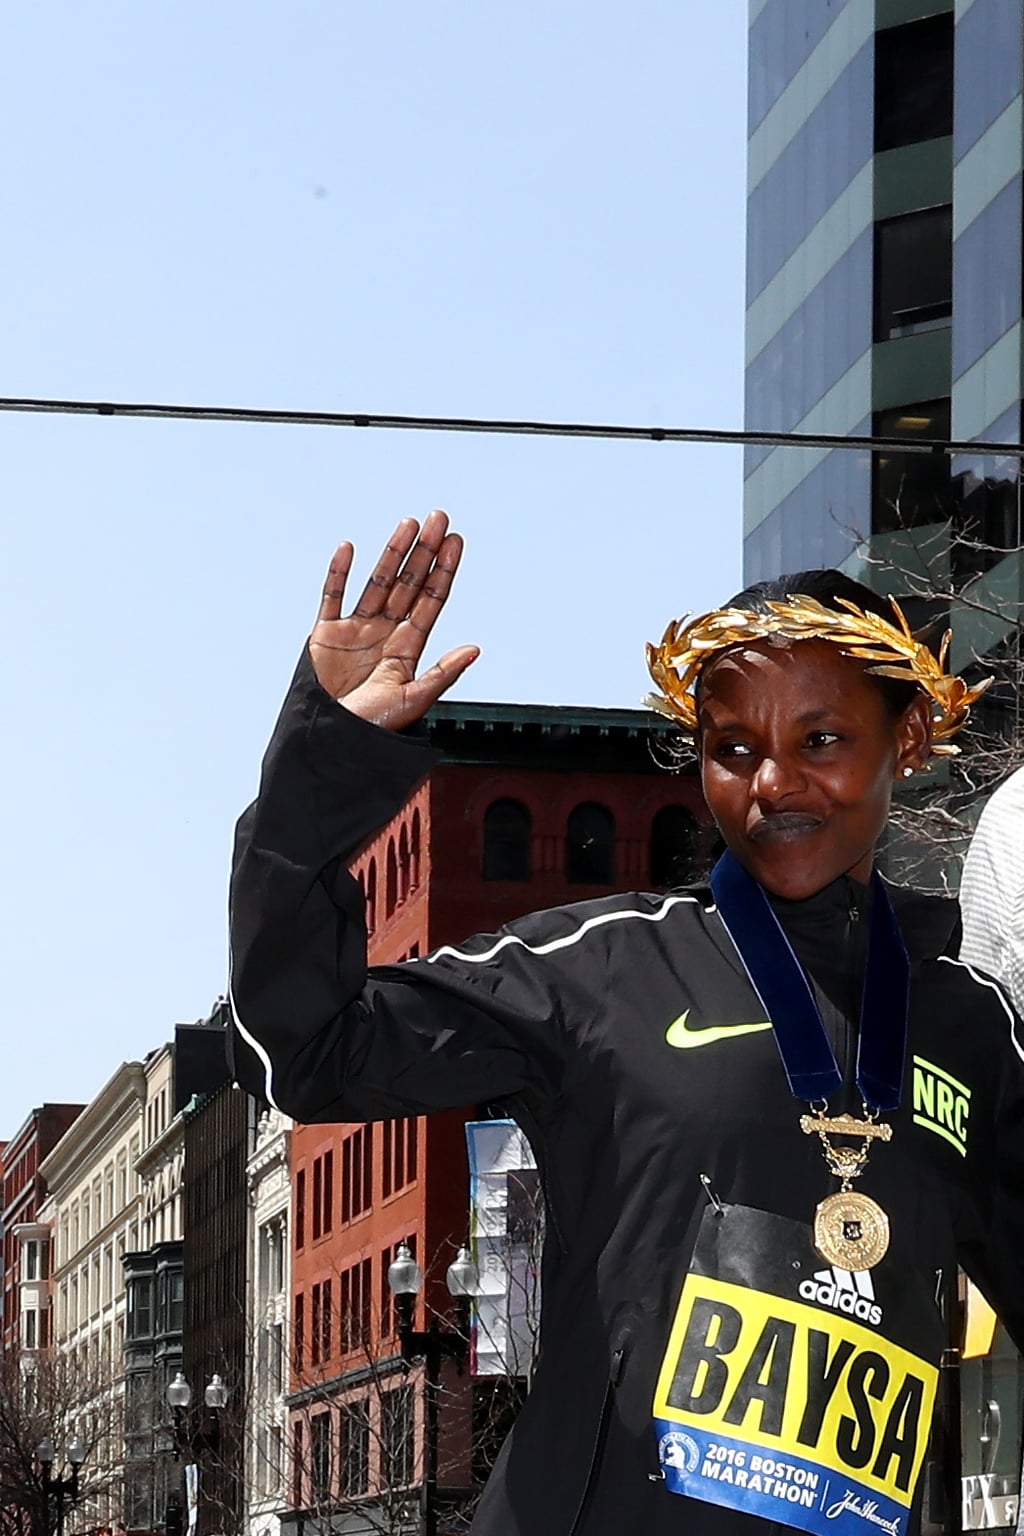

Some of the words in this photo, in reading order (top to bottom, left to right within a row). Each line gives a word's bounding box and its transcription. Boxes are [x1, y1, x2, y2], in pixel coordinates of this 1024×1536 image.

[912, 1068, 970, 1142] NRC
[799, 1278, 882, 1325] adidas
[665, 1296, 925, 1491] BAYSA
[701, 1460, 815, 1508] MARATHON
[705, 1442, 746, 1467] 2016
[750, 1455, 819, 1490] BOSTON
